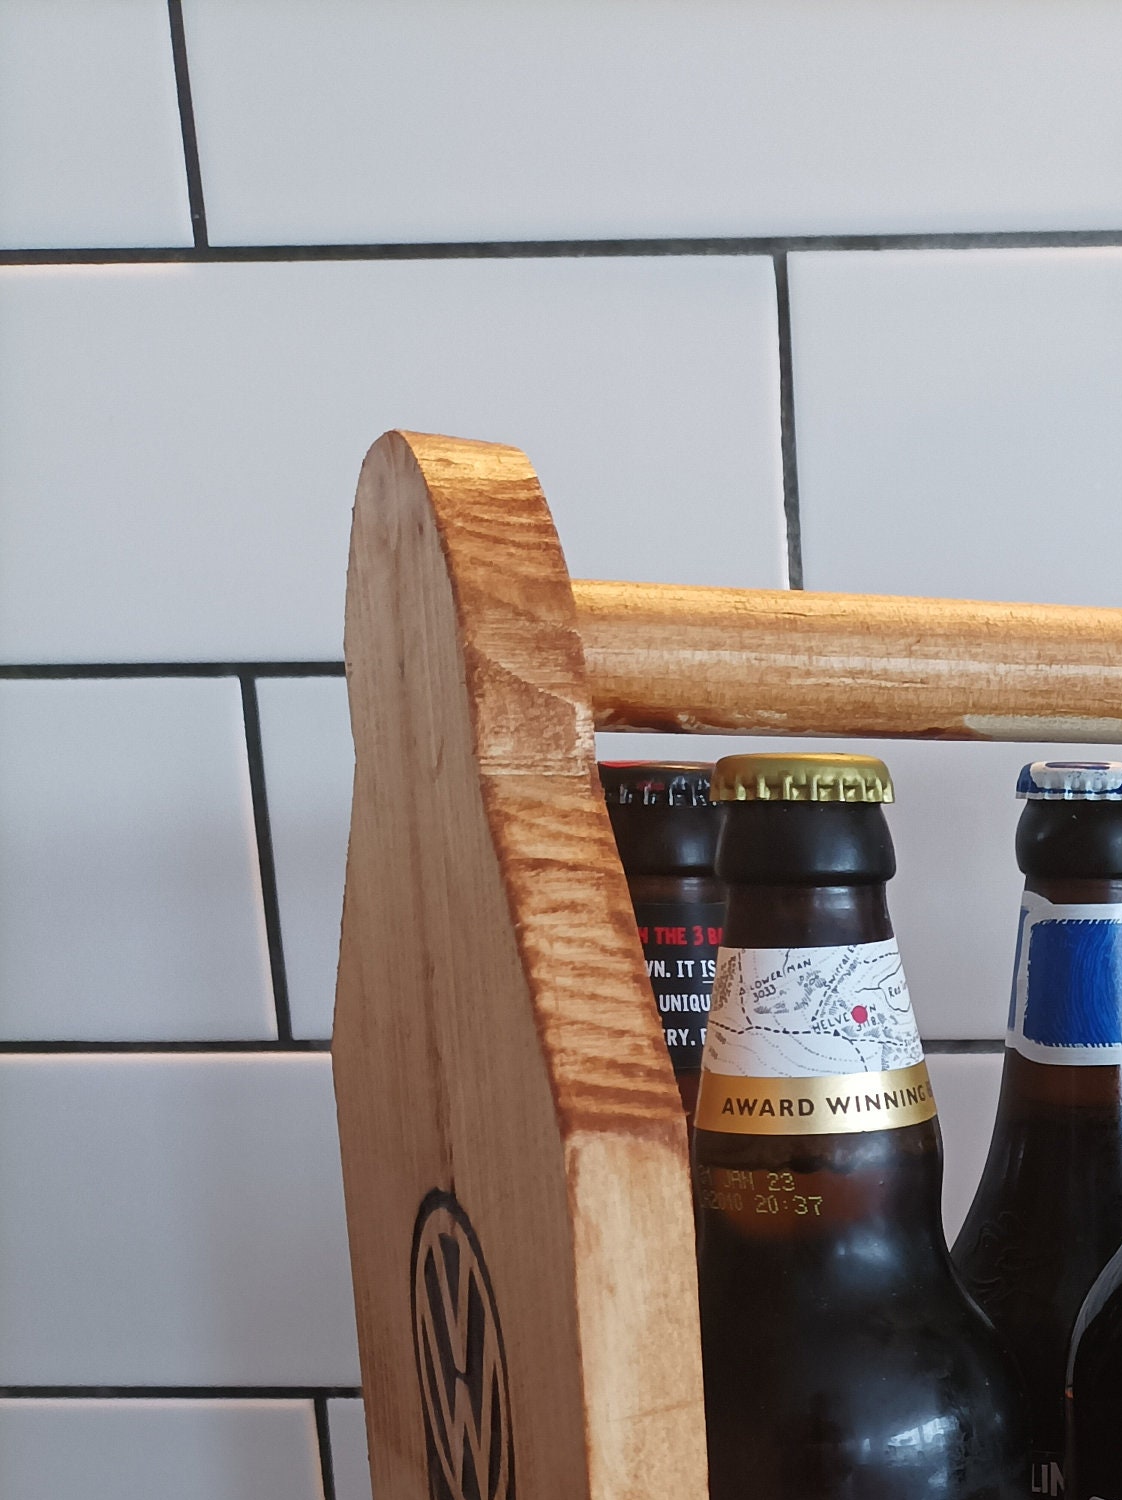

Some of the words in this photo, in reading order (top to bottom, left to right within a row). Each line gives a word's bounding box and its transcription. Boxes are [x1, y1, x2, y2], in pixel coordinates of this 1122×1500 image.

[653, 926, 688, 945] THE
[692, 925, 705, 946] 3
[676, 960, 695, 978] IT
[750, 970, 783, 992] LOWER
[787, 958, 812, 974] MAN
[721, 1097, 815, 1117] AWARD
[826, 1085, 926, 1115] WINNING
[766, 1172, 796, 1191] 23
[754, 1194, 823, 1216] 20:37
